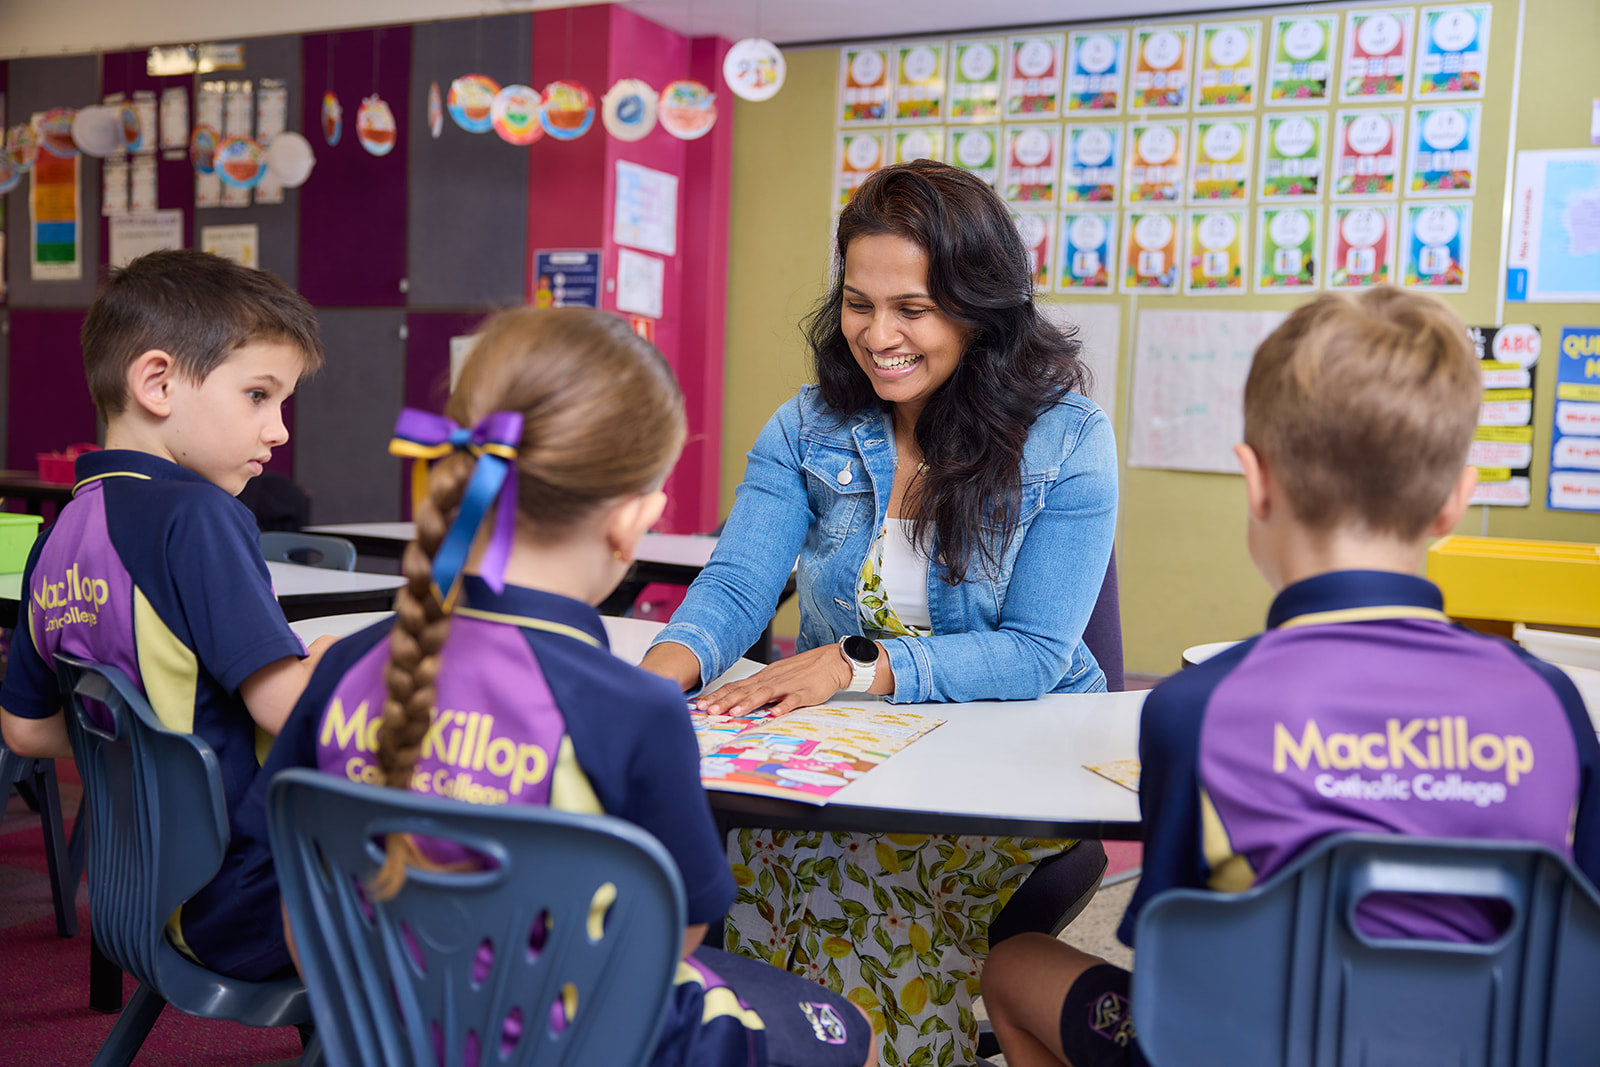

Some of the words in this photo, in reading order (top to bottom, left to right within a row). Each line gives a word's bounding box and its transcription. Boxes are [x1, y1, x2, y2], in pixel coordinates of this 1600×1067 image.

[1501, 336, 1537, 353] ABC
[1273, 716, 1534, 785] MacKillop
[1314, 773, 1411, 801] Catholic
[1412, 773, 1507, 808] College
